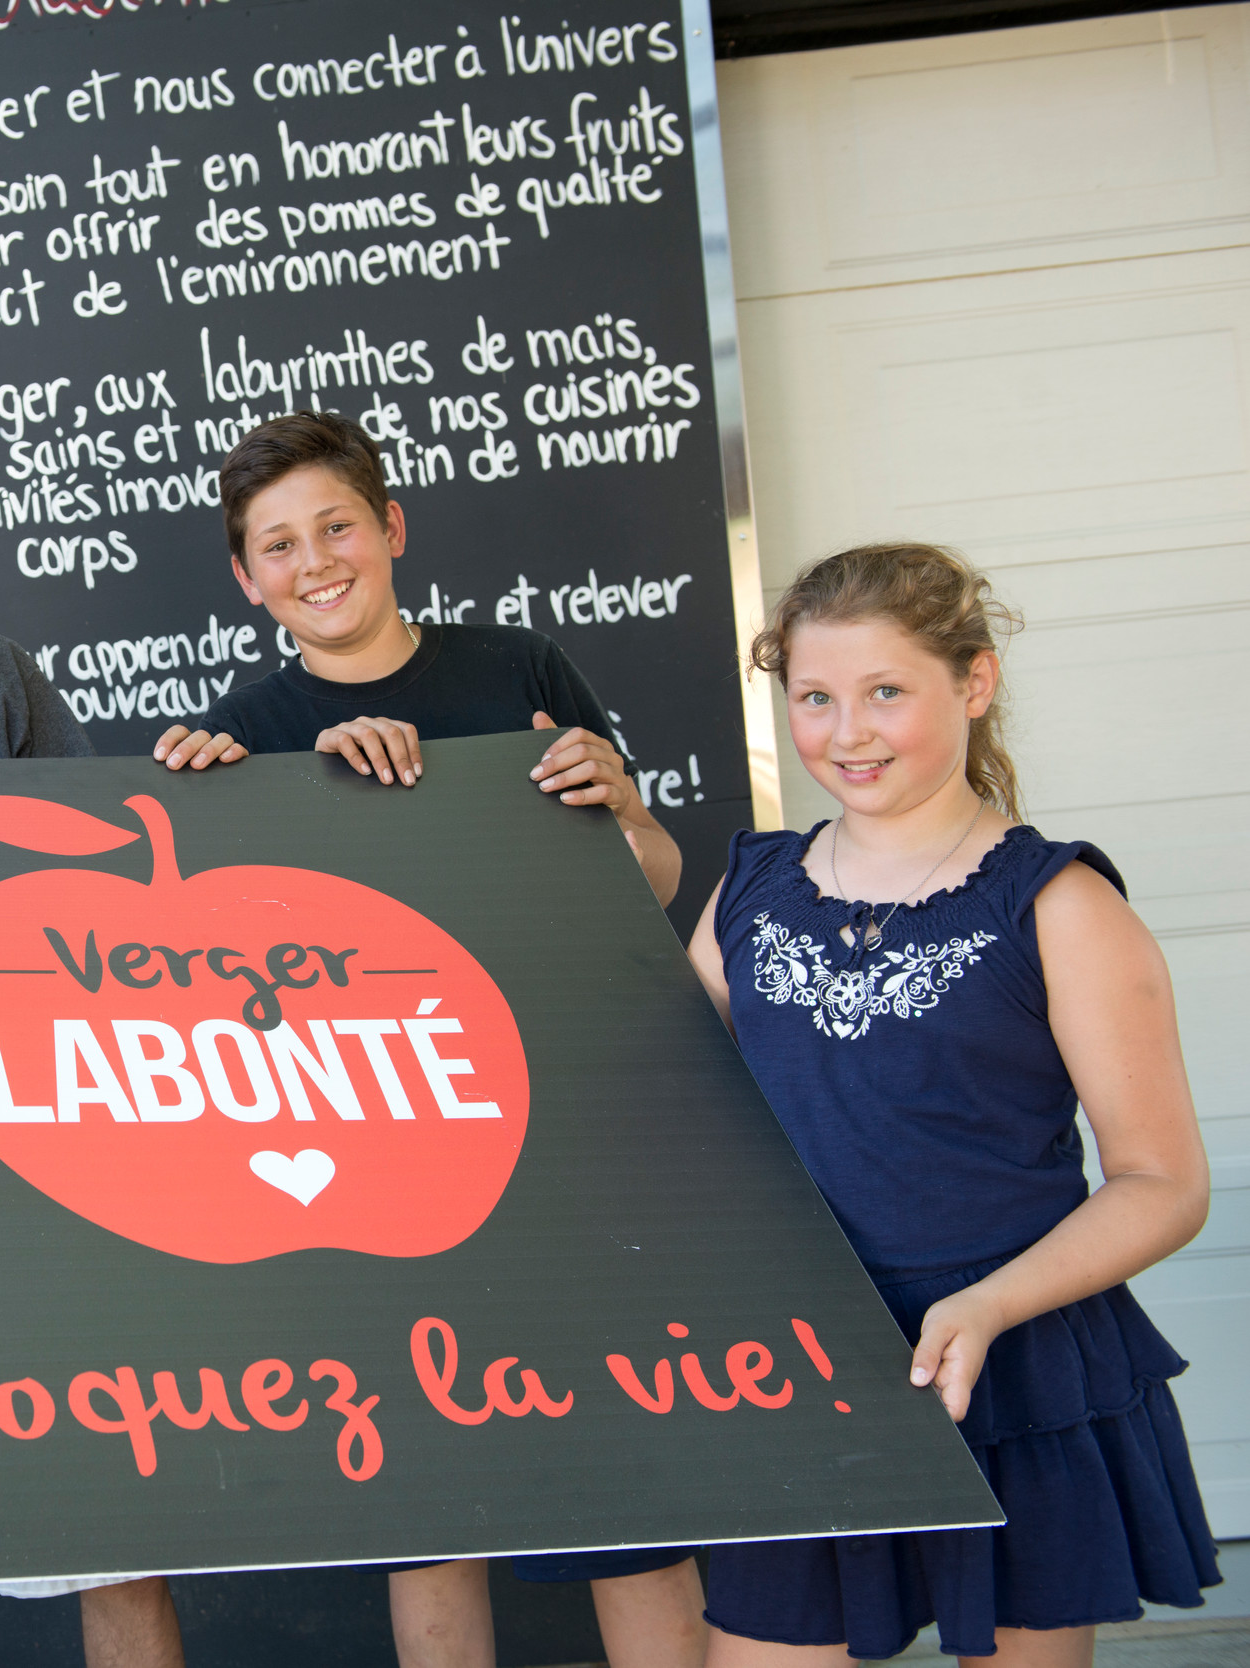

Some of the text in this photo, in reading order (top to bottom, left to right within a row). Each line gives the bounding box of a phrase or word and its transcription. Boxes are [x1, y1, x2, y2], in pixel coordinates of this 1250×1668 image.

[66, 69, 121, 123] et
[134, 67, 235, 114] nous
[253, 34, 447, 101] connecter
[454, 25, 487, 79] à
[500, 15, 678, 76] l'univers
[85, 145, 182, 205] tout
[203, 152, 260, 192] en
[277, 110, 456, 181] honorant
[461, 103, 556, 166] leurs
[564, 86, 684, 167] fruits
[46, 207, 160, 262] offrir
[196, 198, 268, 248] des
[278, 192, 436, 249] pommes
[455, 172, 506, 218] de
[517, 154, 664, 239] qualité
[72, 270, 127, 318] de
[156, 222, 511, 304] l'environnement
[95, 369, 177, 415] aux
[200, 327, 434, 412] labyrinthes
[462, 315, 514, 374] de
[526, 313, 657, 368] maïs,
[6, 427, 126, 480] sains
[133, 408, 181, 463] et
[360, 391, 408, 441] de
[429, 391, 508, 431] nos
[524, 363, 700, 426] cuisines
[468, 430, 520, 482] de
[537, 412, 692, 471] nourrir
[17, 530, 138, 590] corps
[68, 614, 262, 688] apprendre
[495, 574, 540, 629] et
[550, 568, 693, 626] relever
[42, 927, 359, 1031] Verger
[409, 1316, 574, 1426] la
[605, 1317, 851, 1414] vie!
